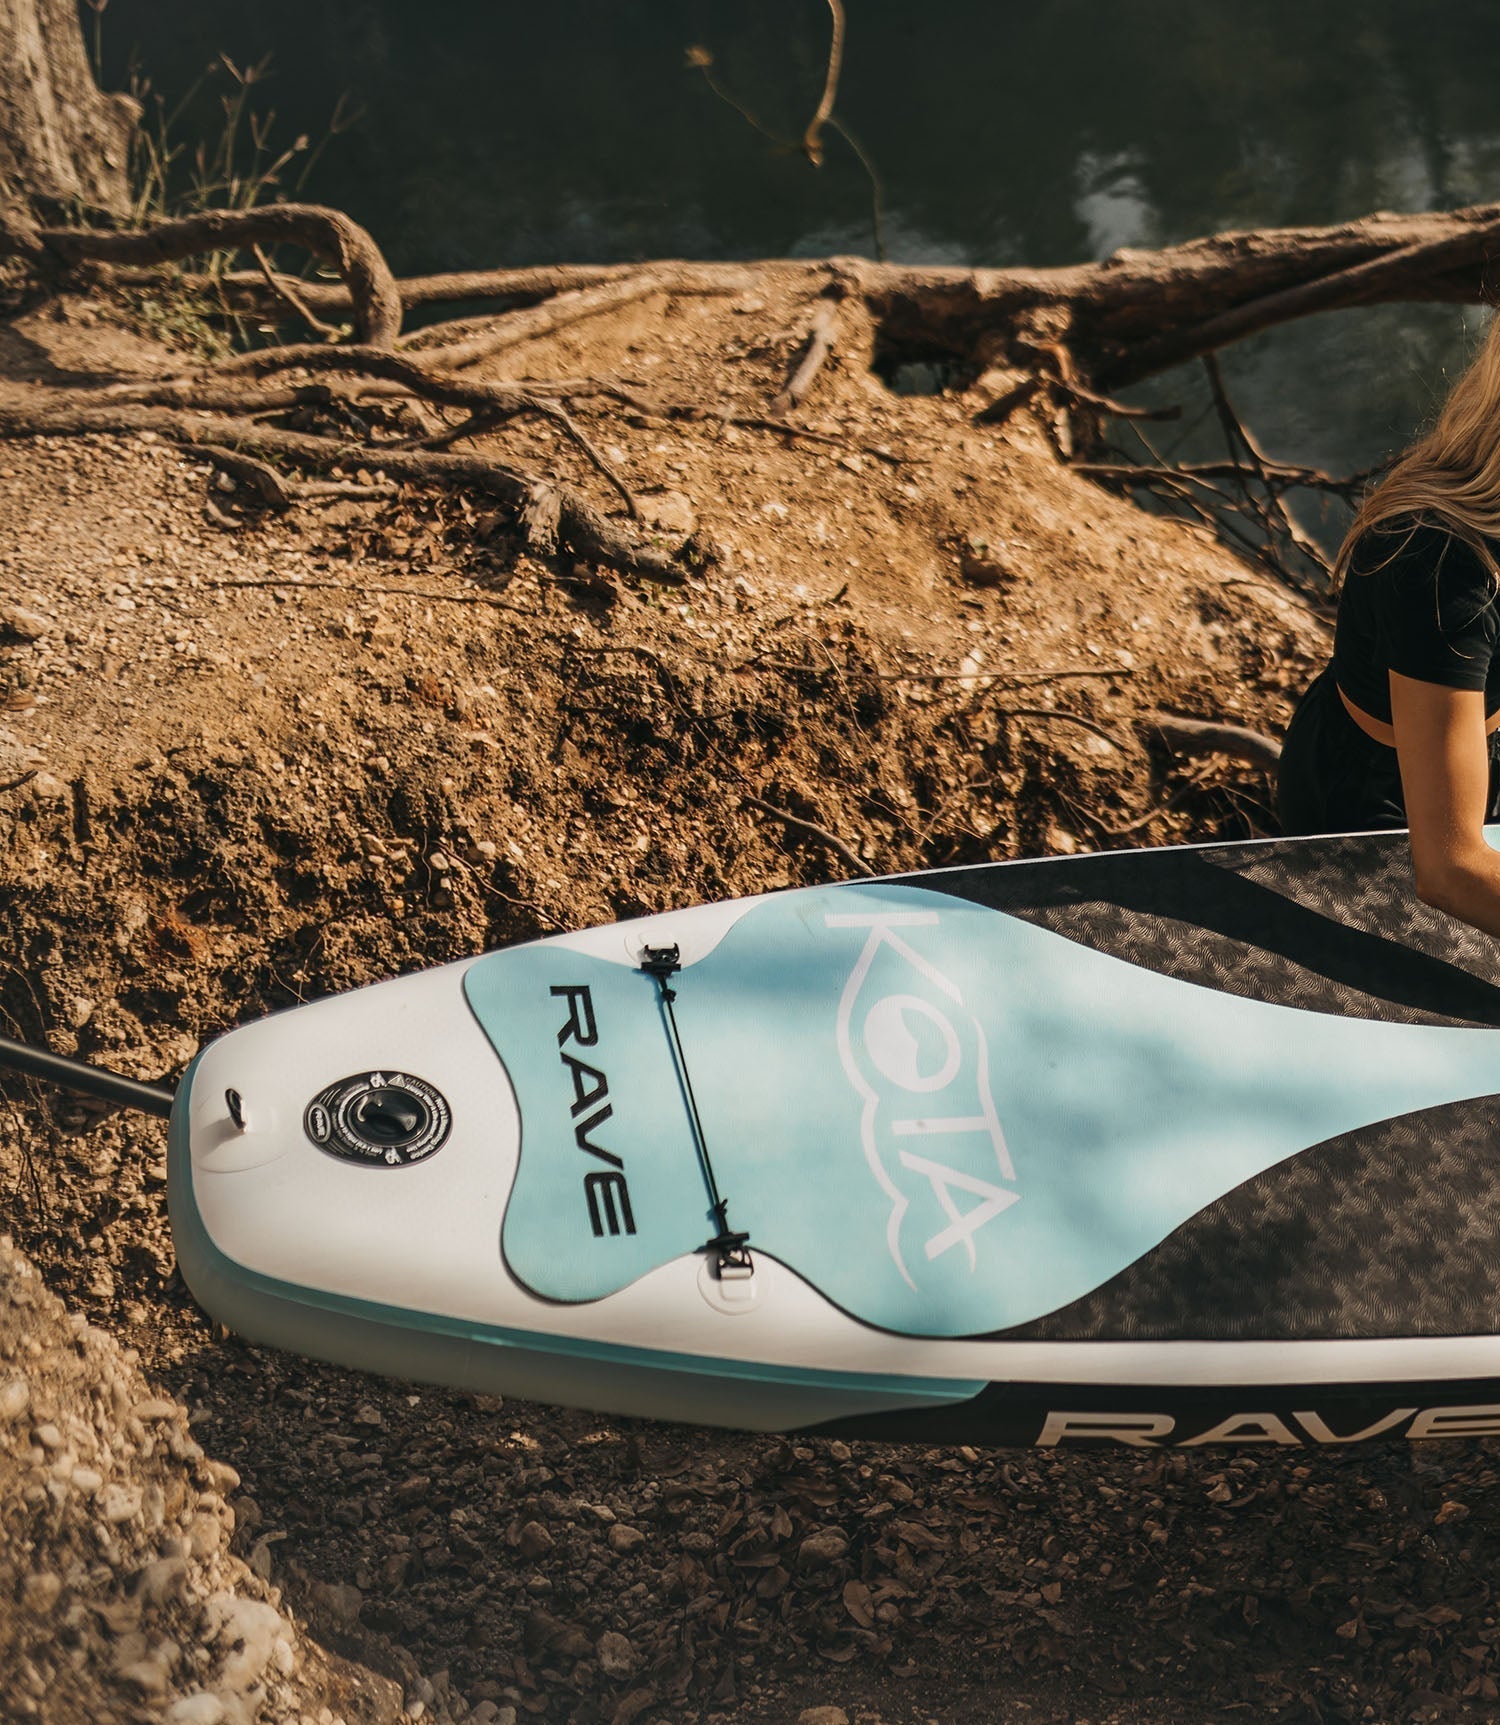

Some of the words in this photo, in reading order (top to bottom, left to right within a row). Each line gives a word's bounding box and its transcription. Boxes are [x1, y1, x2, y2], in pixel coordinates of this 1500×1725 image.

[315, 1109, 326, 1137] RAVE
[549, 985, 637, 1238] RAVE
[825, 911, 1022, 1292] KOTA
